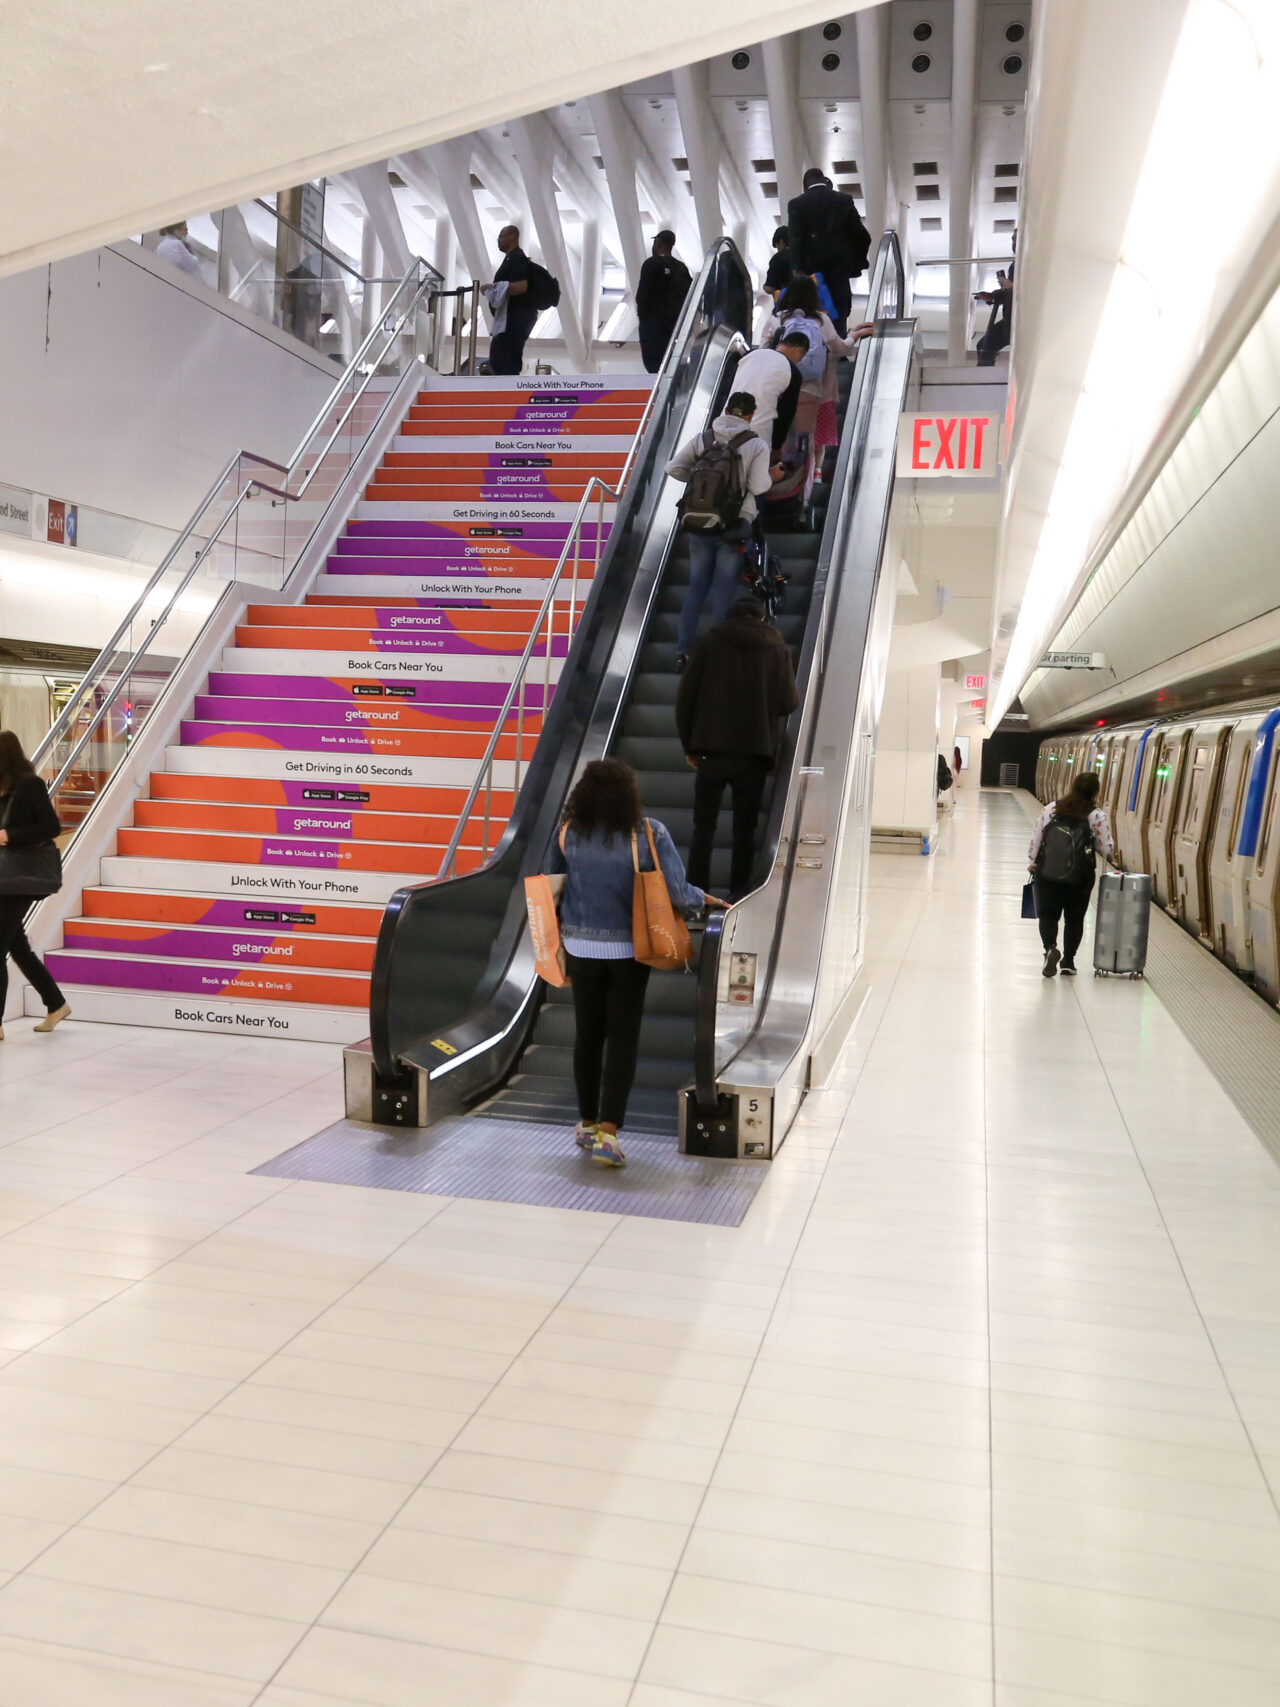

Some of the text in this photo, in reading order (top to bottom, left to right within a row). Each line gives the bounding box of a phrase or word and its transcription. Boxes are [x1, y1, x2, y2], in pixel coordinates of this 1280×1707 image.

[526, 411, 567, 420] getaround
[911, 417, 989, 469] EXIT
[496, 475, 540, 485] getaround
[10, 504, 29, 523] Street
[453, 510, 555, 519] Get Driving in 60 Seconds
[48, 513, 64, 532] Exit
[464, 546, 510, 556] getaround
[421, 584, 522, 594] Unlock With Your Phone
[390, 615, 441, 627] getaround
[348, 660, 443, 672] Book Cars Near You
[966, 676, 984, 688] EXIT
[345, 710, 399, 722] getaround
[377, 738, 394, 746] Drive
[285, 762, 413, 776] Get Driving in 60 Seconds
[294, 818, 351, 830] getaround
[294, 850, 318, 858] Unlock
[231, 876, 359, 893] Unlock With Your Phone
[232, 943, 293, 956] getaround
[202, 976, 284, 990] Book Unlock Drive
[174, 1008, 289, 1029] Book Cars Near You
[749, 1099, 758, 1112] 5
